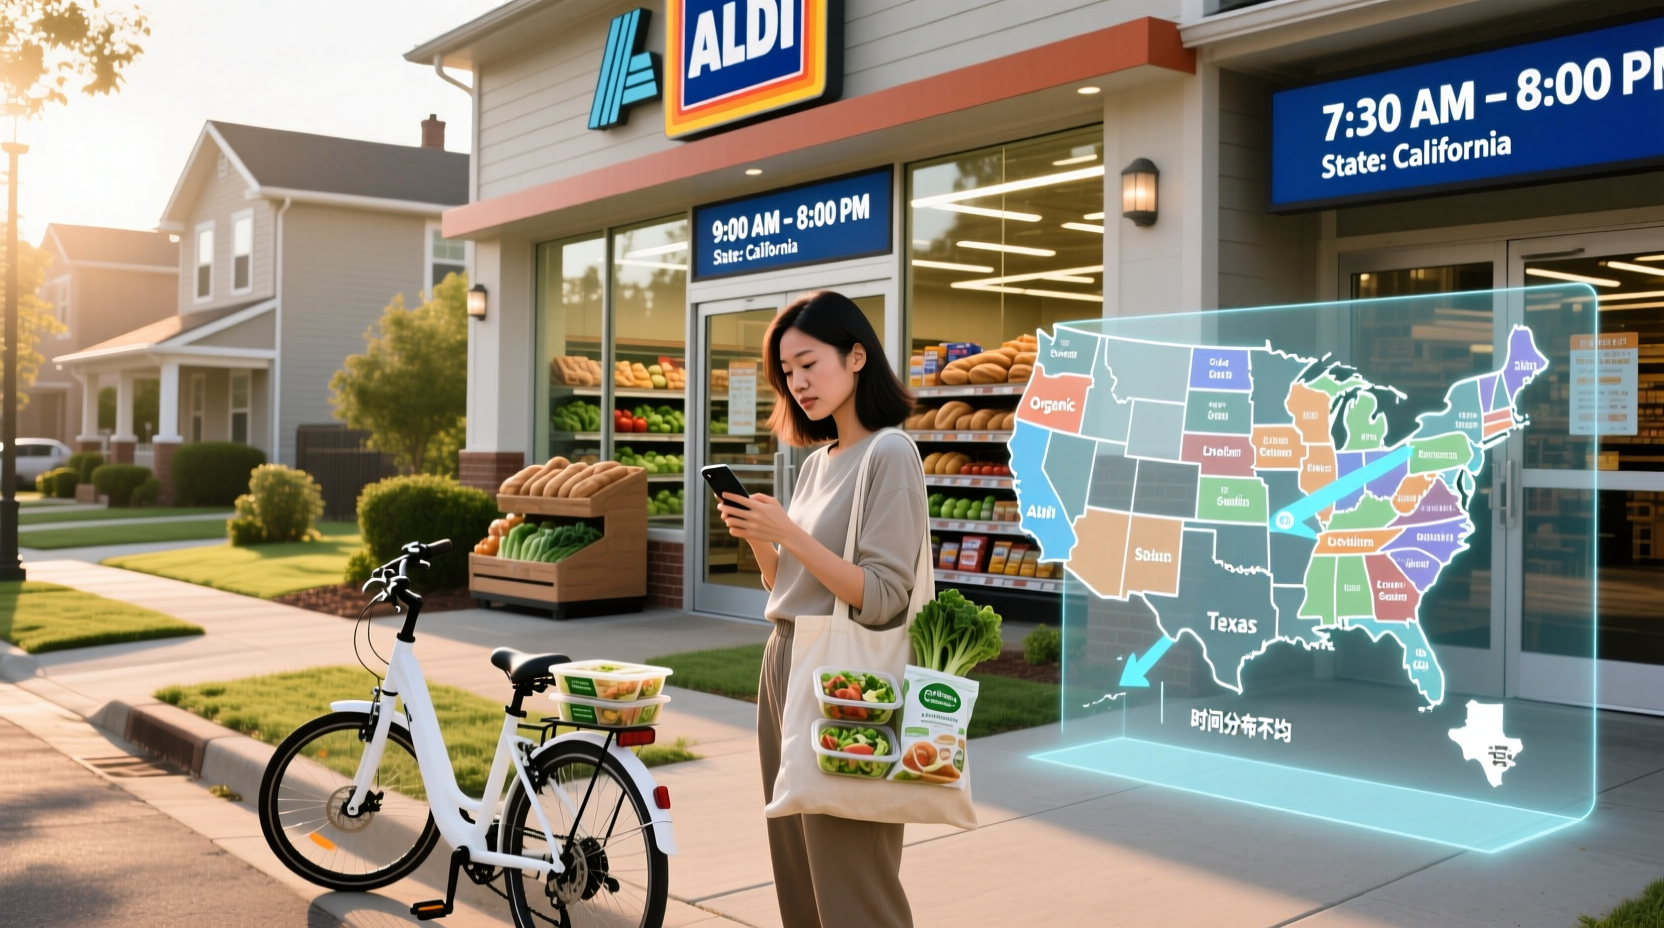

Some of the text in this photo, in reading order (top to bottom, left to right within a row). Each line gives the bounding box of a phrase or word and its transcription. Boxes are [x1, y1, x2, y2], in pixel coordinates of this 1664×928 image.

[688, 0, 795, 79] ALDI
[1322, 93, 1402, 142] 7:30
[1410, 80, 1475, 129] AM
[1516, 57, 1611, 111] 8:00
[1622, 46, 1664, 96] P
[1321, 130, 1512, 179] State: California
[712, 216, 749, 243] 9:00
[751, 209, 781, 237] AM
[796, 200, 836, 231] 8:00
[840, 193, 870, 223] PM
[745, 239, 798, 261] California
[1030, 396, 1076, 414] Organic
[1207, 611, 1258, 634] Texas
[1190, 708, 1292, 743] 时间分布不均
